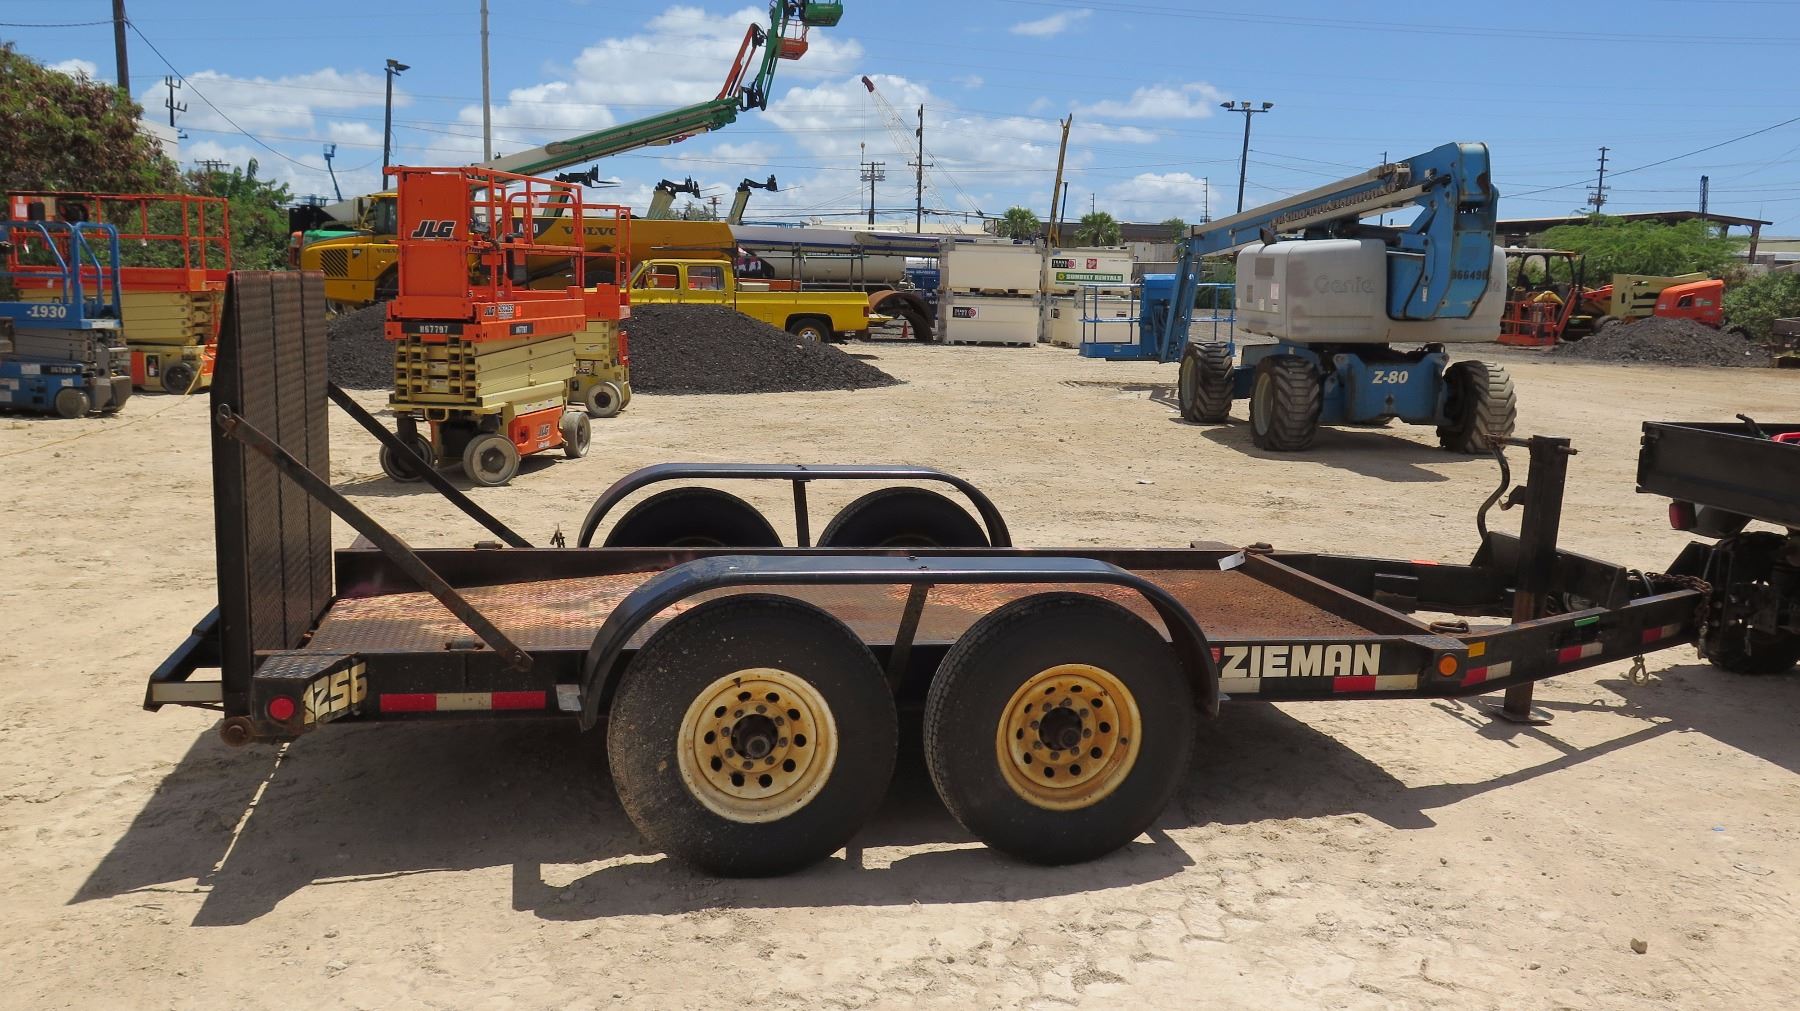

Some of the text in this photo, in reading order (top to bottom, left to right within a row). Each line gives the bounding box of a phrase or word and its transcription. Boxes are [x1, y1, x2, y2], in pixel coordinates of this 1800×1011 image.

[411, 220, 457, 239] JLG
[518, 223, 539, 233] A0
[561, 226, 618, 236] VLVO
[1066, 273, 1123, 282] SUNBELT RENTALS
[1314, 274, 1377, 294] Genie
[1372, 371, 1409, 384] Z-80
[1221, 643, 1382, 679] ZIEMAN
